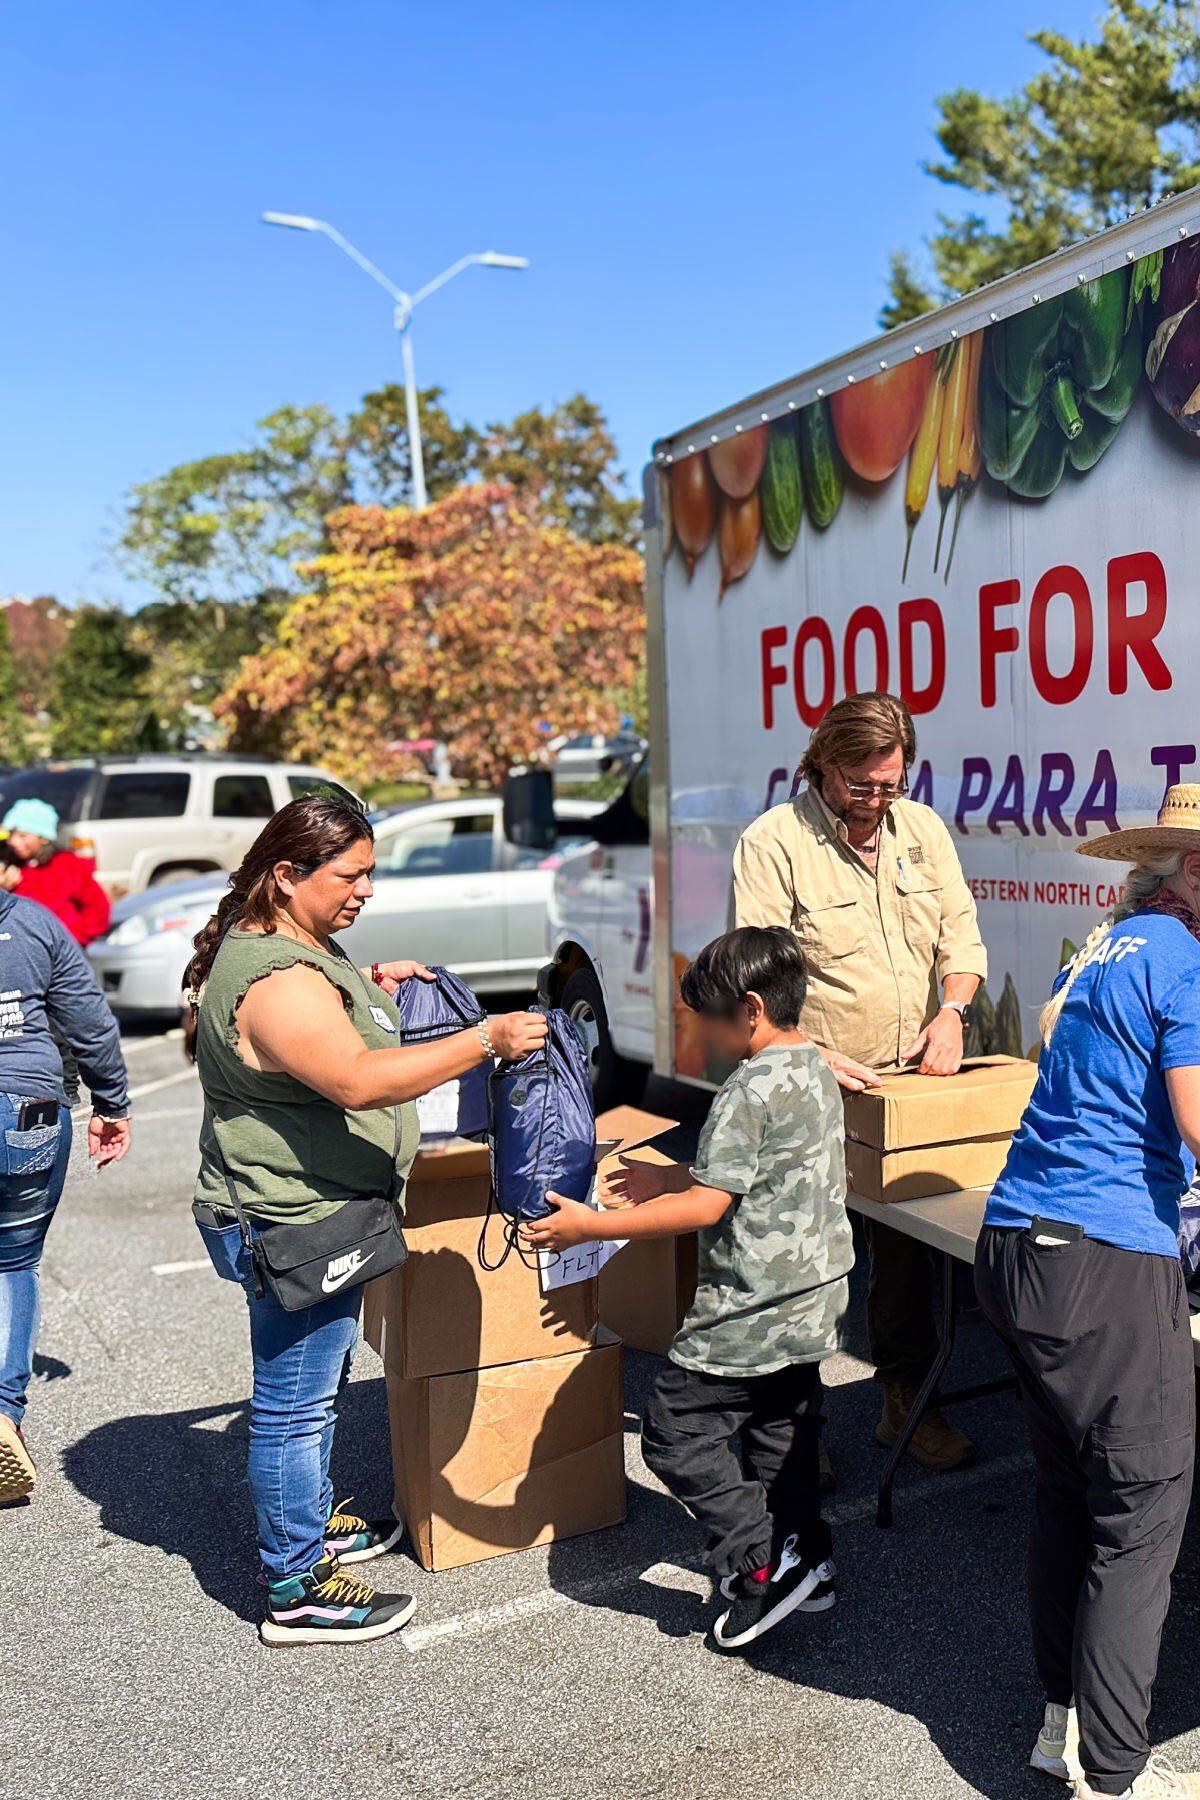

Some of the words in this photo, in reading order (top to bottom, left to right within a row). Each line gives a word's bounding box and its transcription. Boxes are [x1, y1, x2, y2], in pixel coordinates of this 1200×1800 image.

[760, 597, 946, 730] FOOD
[978, 551, 1172, 708] FOR
[955, 749, 1122, 836] PARA
[1033, 881, 1090, 906] NORTH
[1064, 936, 1148, 969] AFF
[328, 1249, 362, 1280] NIKE
